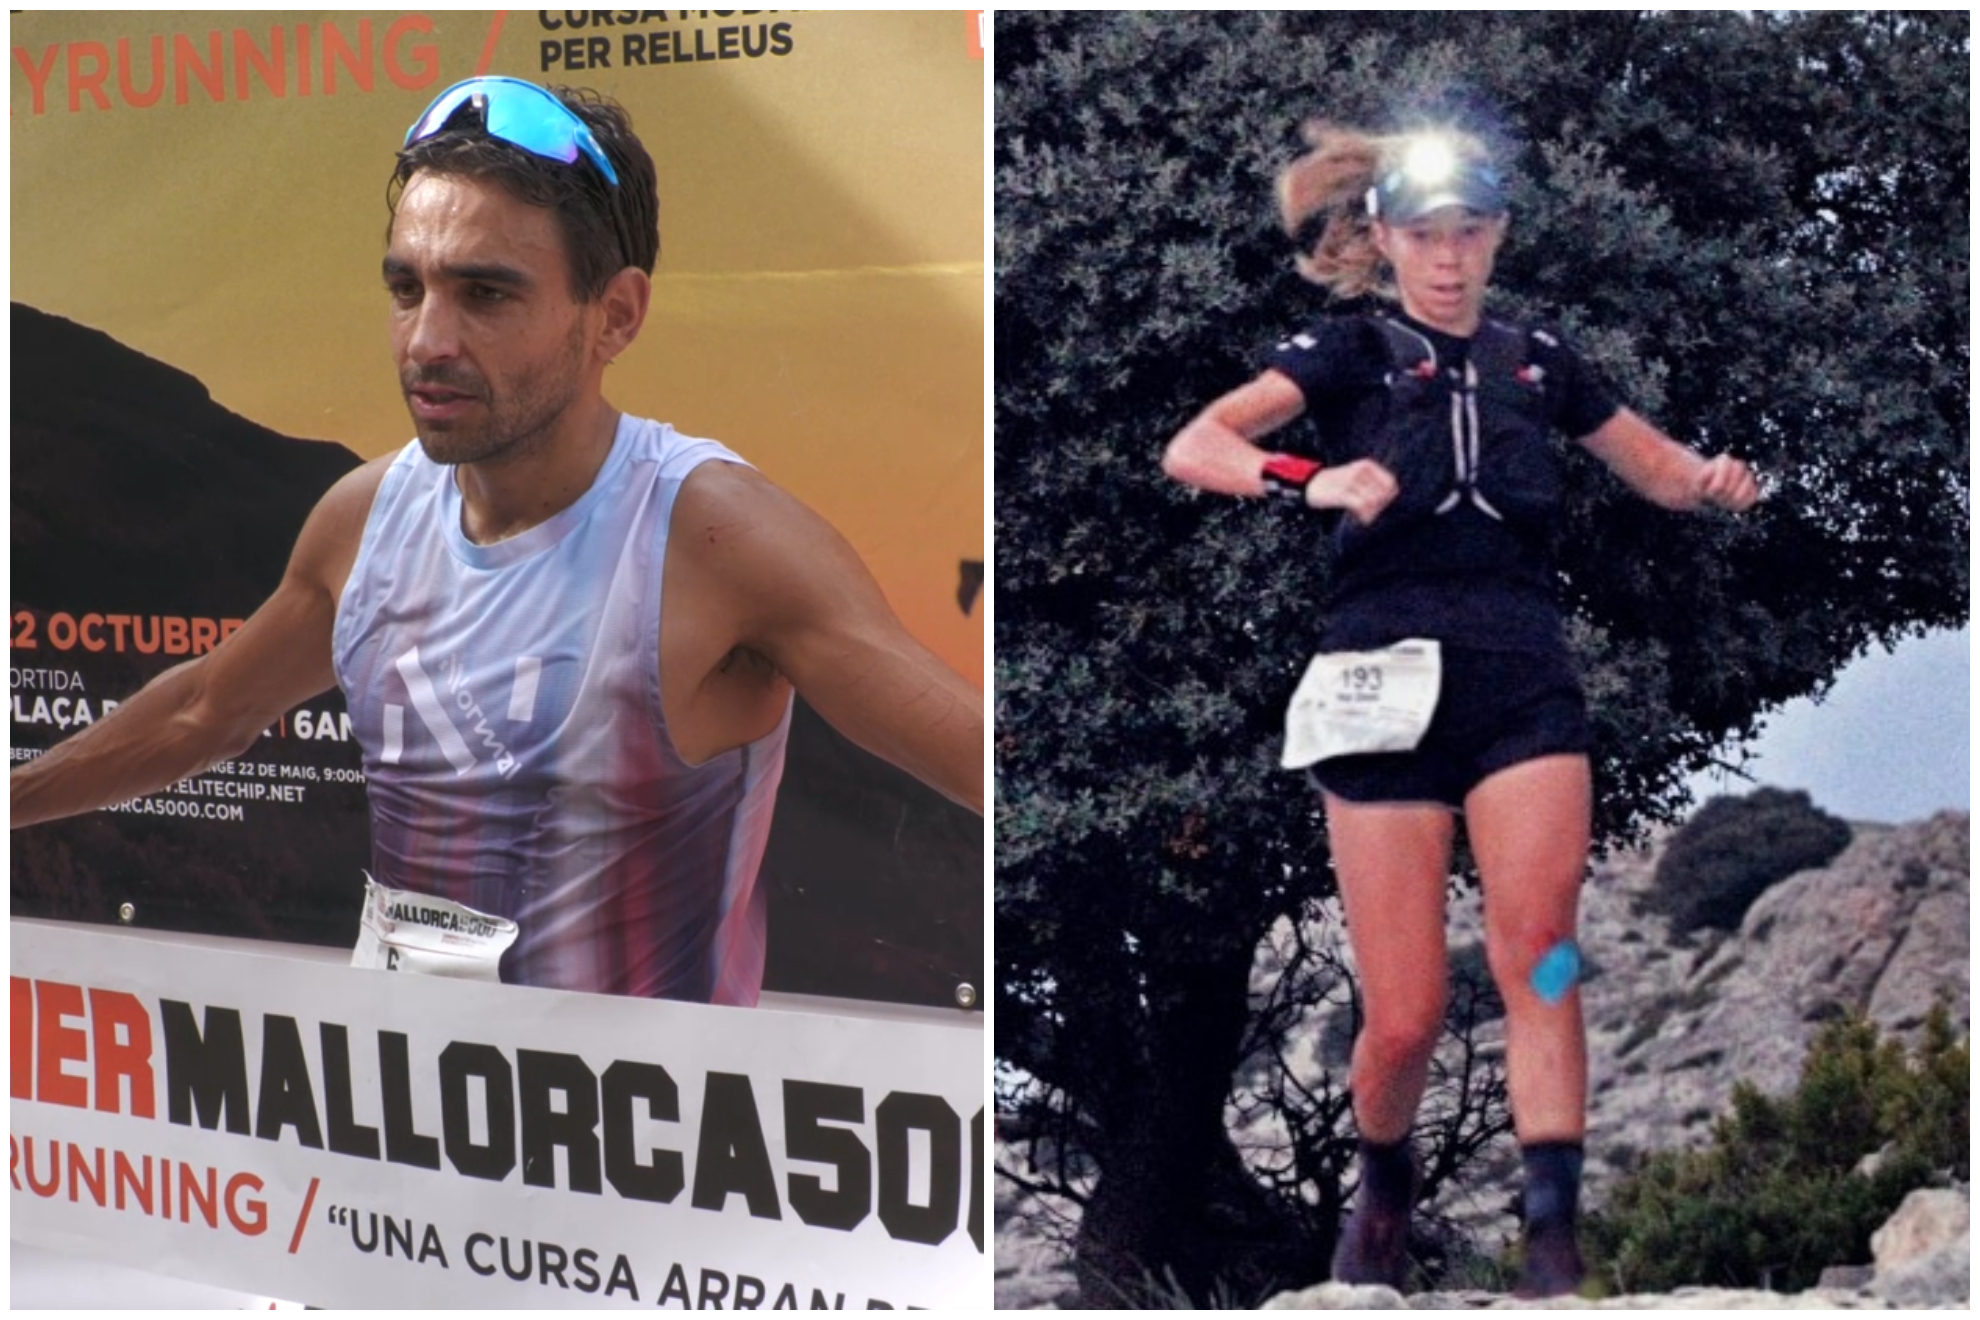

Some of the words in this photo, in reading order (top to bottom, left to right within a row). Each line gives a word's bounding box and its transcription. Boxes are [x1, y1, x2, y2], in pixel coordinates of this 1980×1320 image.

[10, 14, 440, 116] YRUNNING
[540, 36, 611, 72] PER
[623, 22, 794, 67] RELLEUS
[10, 695, 93, 731] LAÇA
[163, 777, 306, 803] .ELITECHIP.NET
[238, 762, 255, 776] 22
[258, 763, 277, 778] DE
[280, 764, 320, 782] MAIG,
[98, 797, 244, 821] RCA5000.COM
[464, 1232, 640, 1302] CURSA
